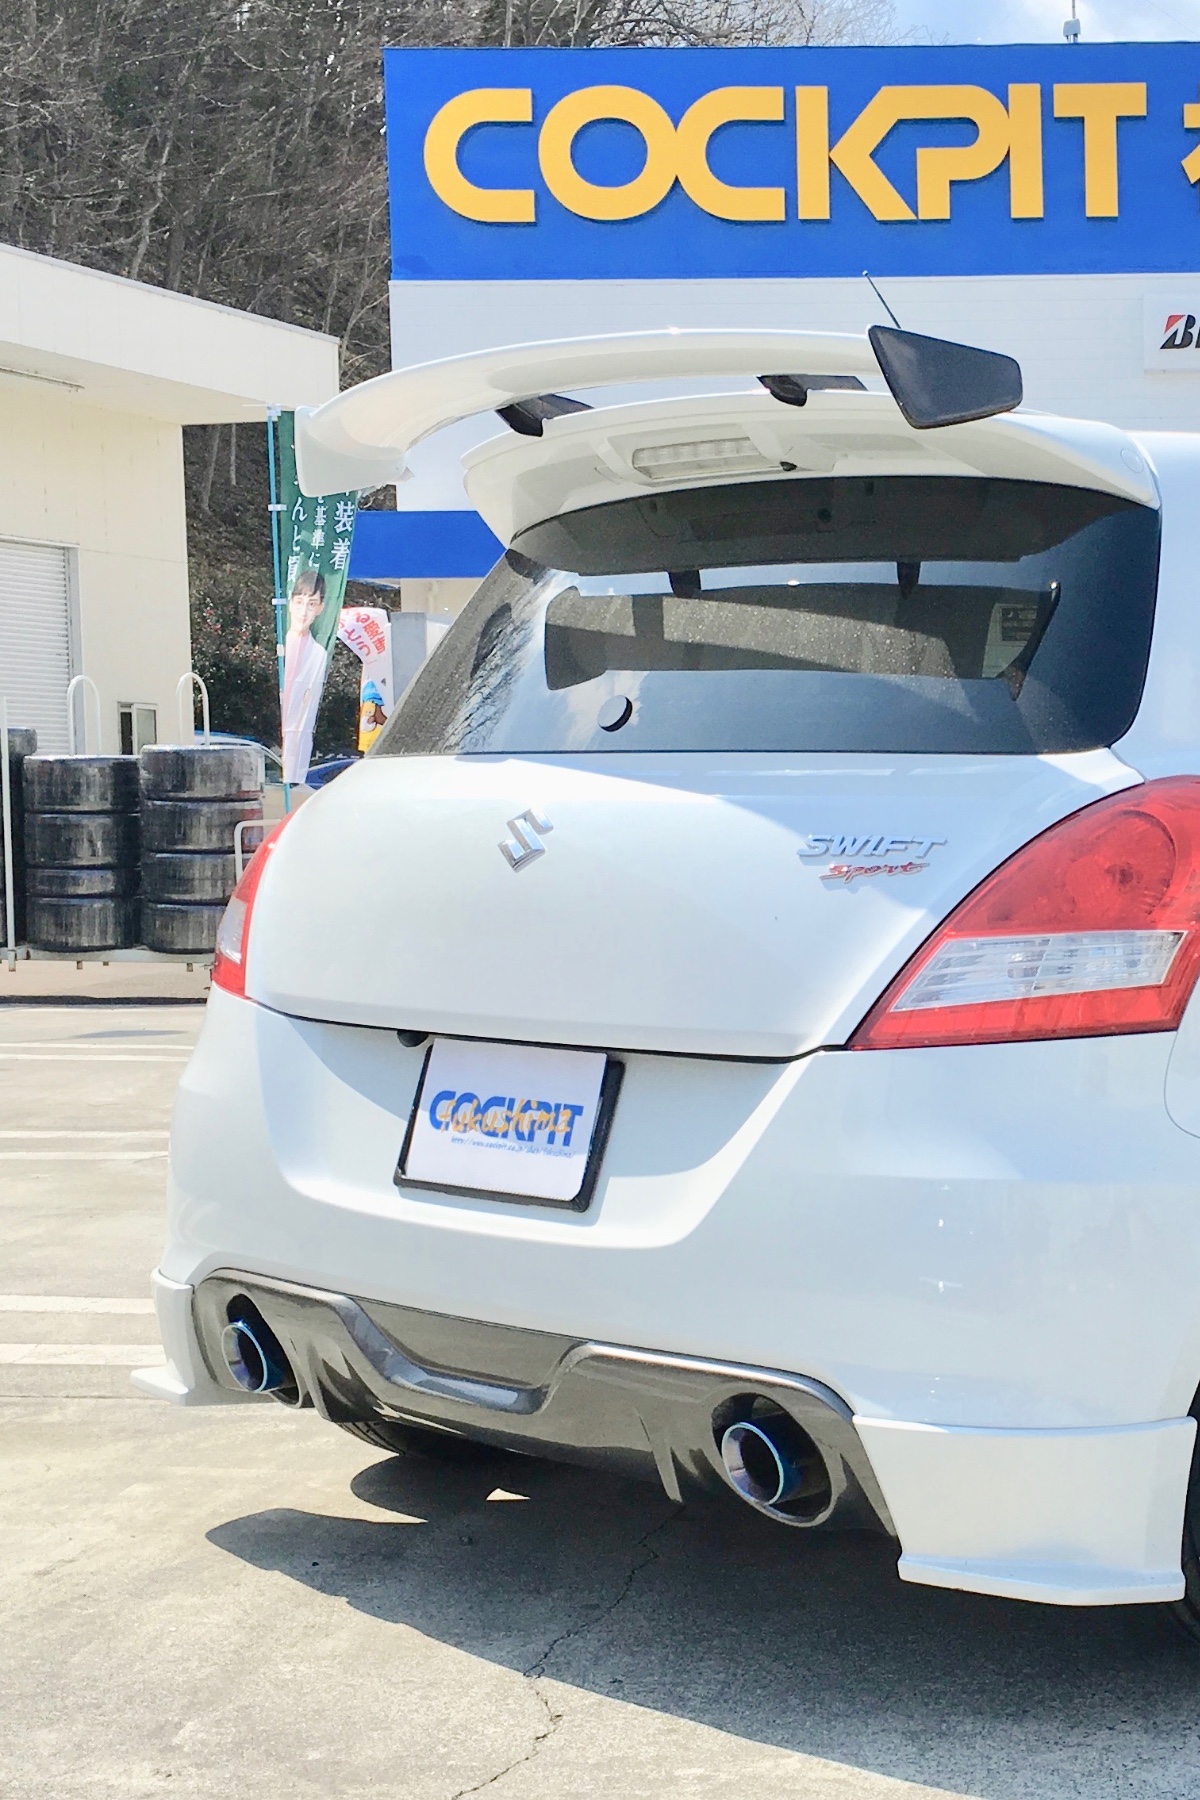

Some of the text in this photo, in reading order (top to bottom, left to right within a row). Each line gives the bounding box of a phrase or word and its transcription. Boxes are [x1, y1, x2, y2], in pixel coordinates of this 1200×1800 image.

[423, 82, 1148, 224] COCKPIT
[330, 489, 355, 571] 装着
[796, 833, 948, 859] SWIFT
[819, 861, 931, 884] Sport
[429, 1090, 585, 1147] COCKPIT
